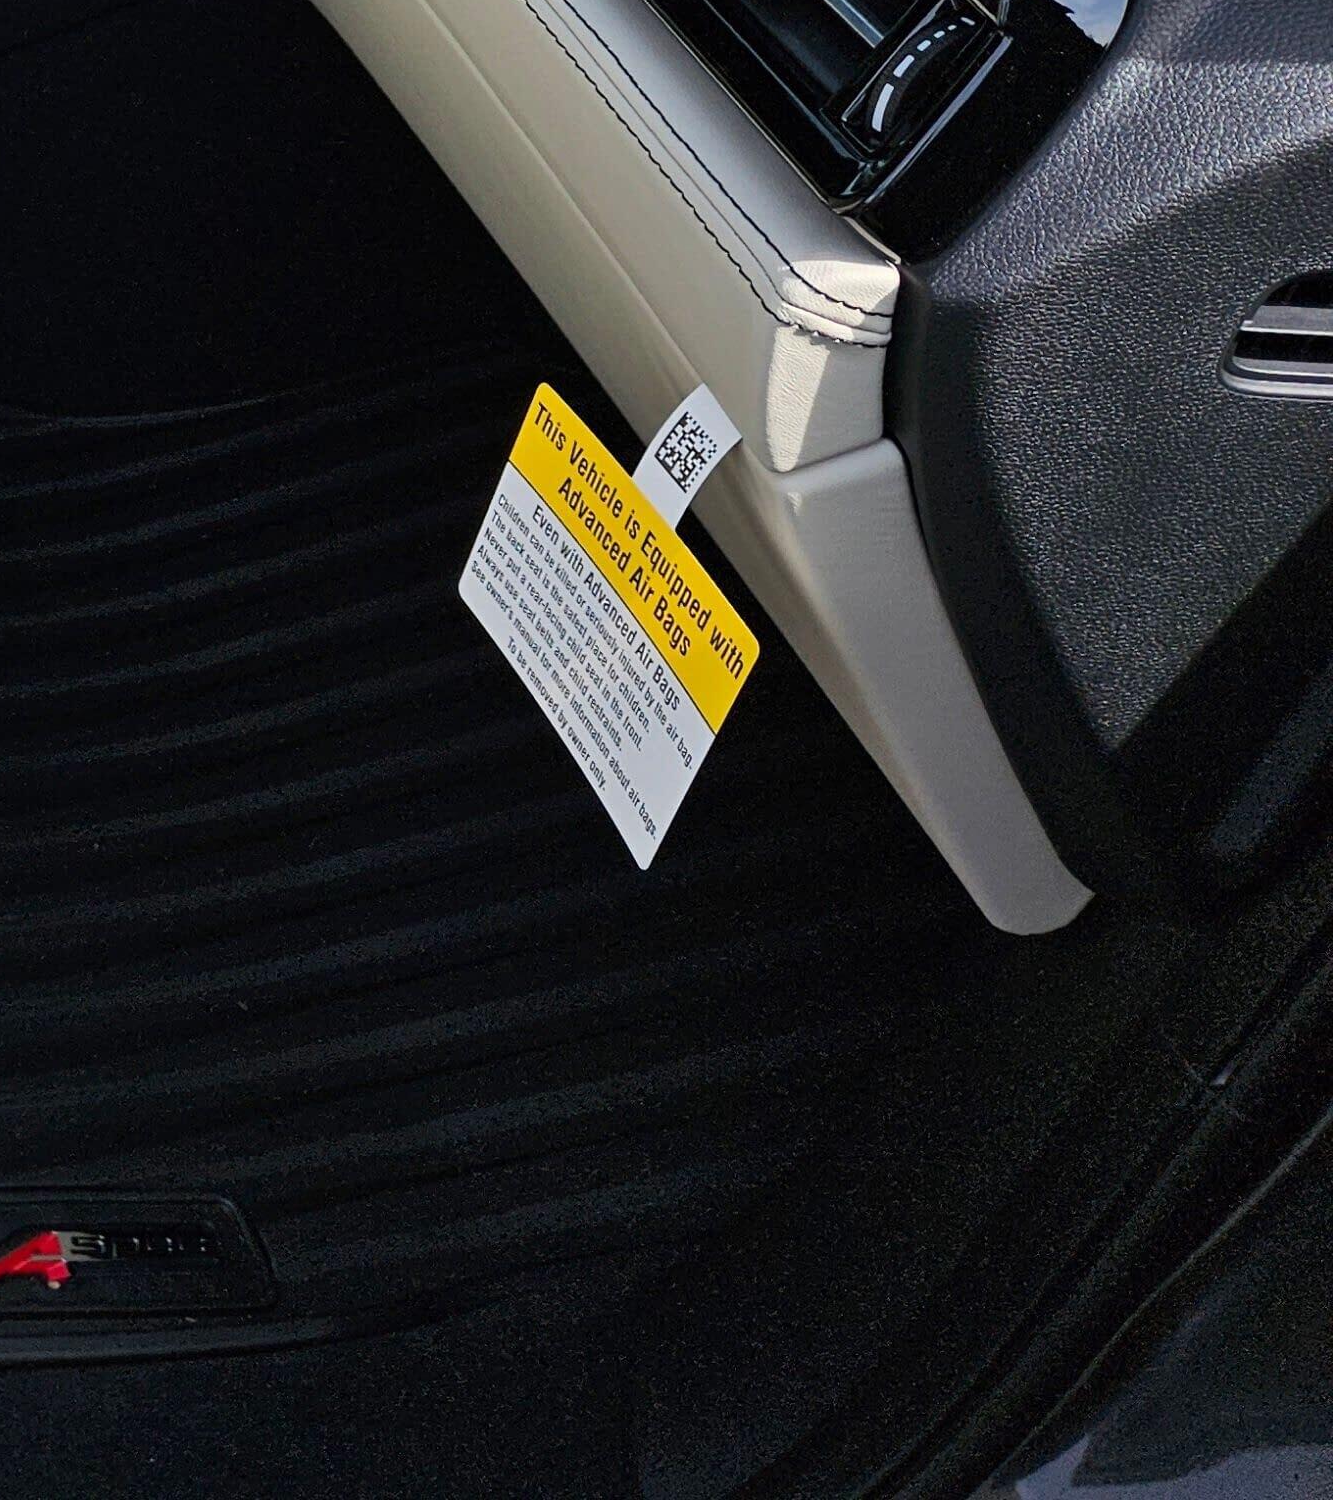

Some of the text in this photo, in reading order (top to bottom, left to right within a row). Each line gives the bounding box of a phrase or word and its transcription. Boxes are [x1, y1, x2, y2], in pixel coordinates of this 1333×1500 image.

[476, 544, 505, 583] Always
[504, 579, 519, 601] use
[518, 597, 537, 624] seat
[534, 617, 555, 649] belts
[553, 646, 571, 669] and
[568, 667, 589, 697] child
[483, 526, 508, 560] Never
[505, 557, 522, 578] put
[520, 574, 526, 585] a
[566, 635, 587, 665] child
[585, 662, 604, 690] seat
[601, 684, 611, 702] in
[610, 696, 624, 721] the
[491, 508, 506, 534] The
[506, 528, 526, 558] back
[524, 553, 543, 580] seat
[541, 573, 551, 590] is
[550, 585, 564, 607] the
[584, 635, 608, 668] place
[606, 662, 620, 684] for
[618, 681, 650, 734] children.
[498, 493, 693, 770] Children can be killed or seriously injured by the air bag.
[532, 504, 680, 711] Even with Advanced Air Bags
[534, 401, 744, 680] This Vehicle is Equipped with
[557, 476, 691, 657] Advanced Air Bags
[471, 560, 486, 584] See
[512, 617, 542, 657] manual
[540, 652, 552, 672] for
[550, 669, 571, 700] more
[608, 756, 631, 792] about
[627, 787, 641, 808] air
[638, 802, 657, 841] bags.
[507, 635, 607, 791] To be removed by owner only.
